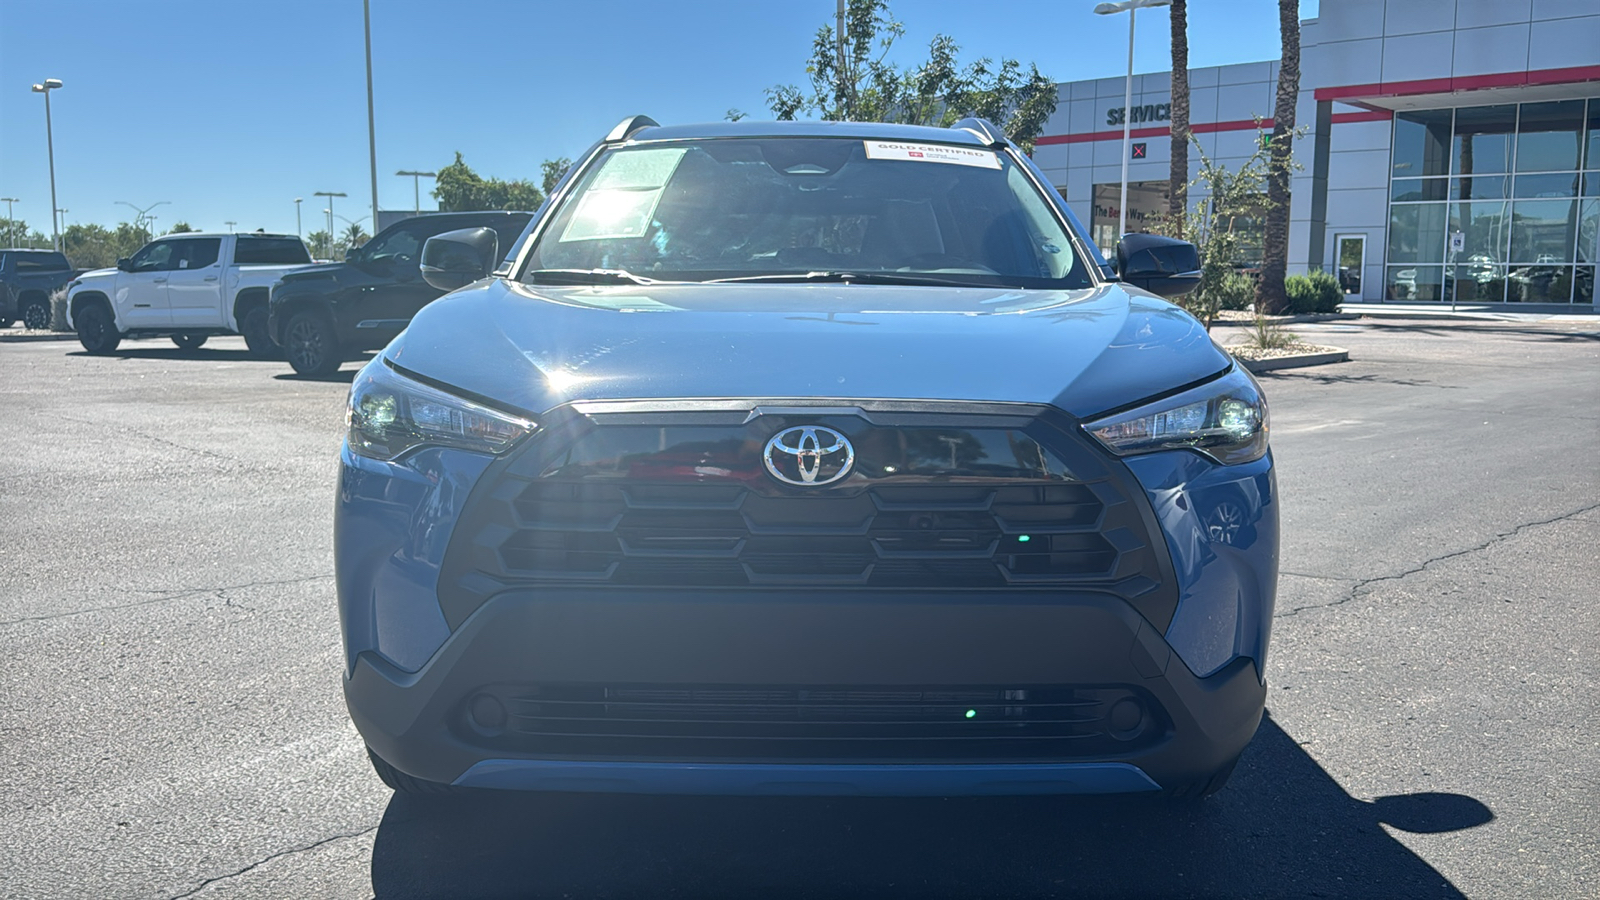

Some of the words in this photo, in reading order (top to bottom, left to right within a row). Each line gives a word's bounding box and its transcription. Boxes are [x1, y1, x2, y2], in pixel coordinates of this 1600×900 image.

[1106, 103, 1172, 126] SERVICE
[877, 143, 917, 151] GOLD
[918, 146, 985, 158] CERTIFIED
[1095, 205, 1108, 217] The
